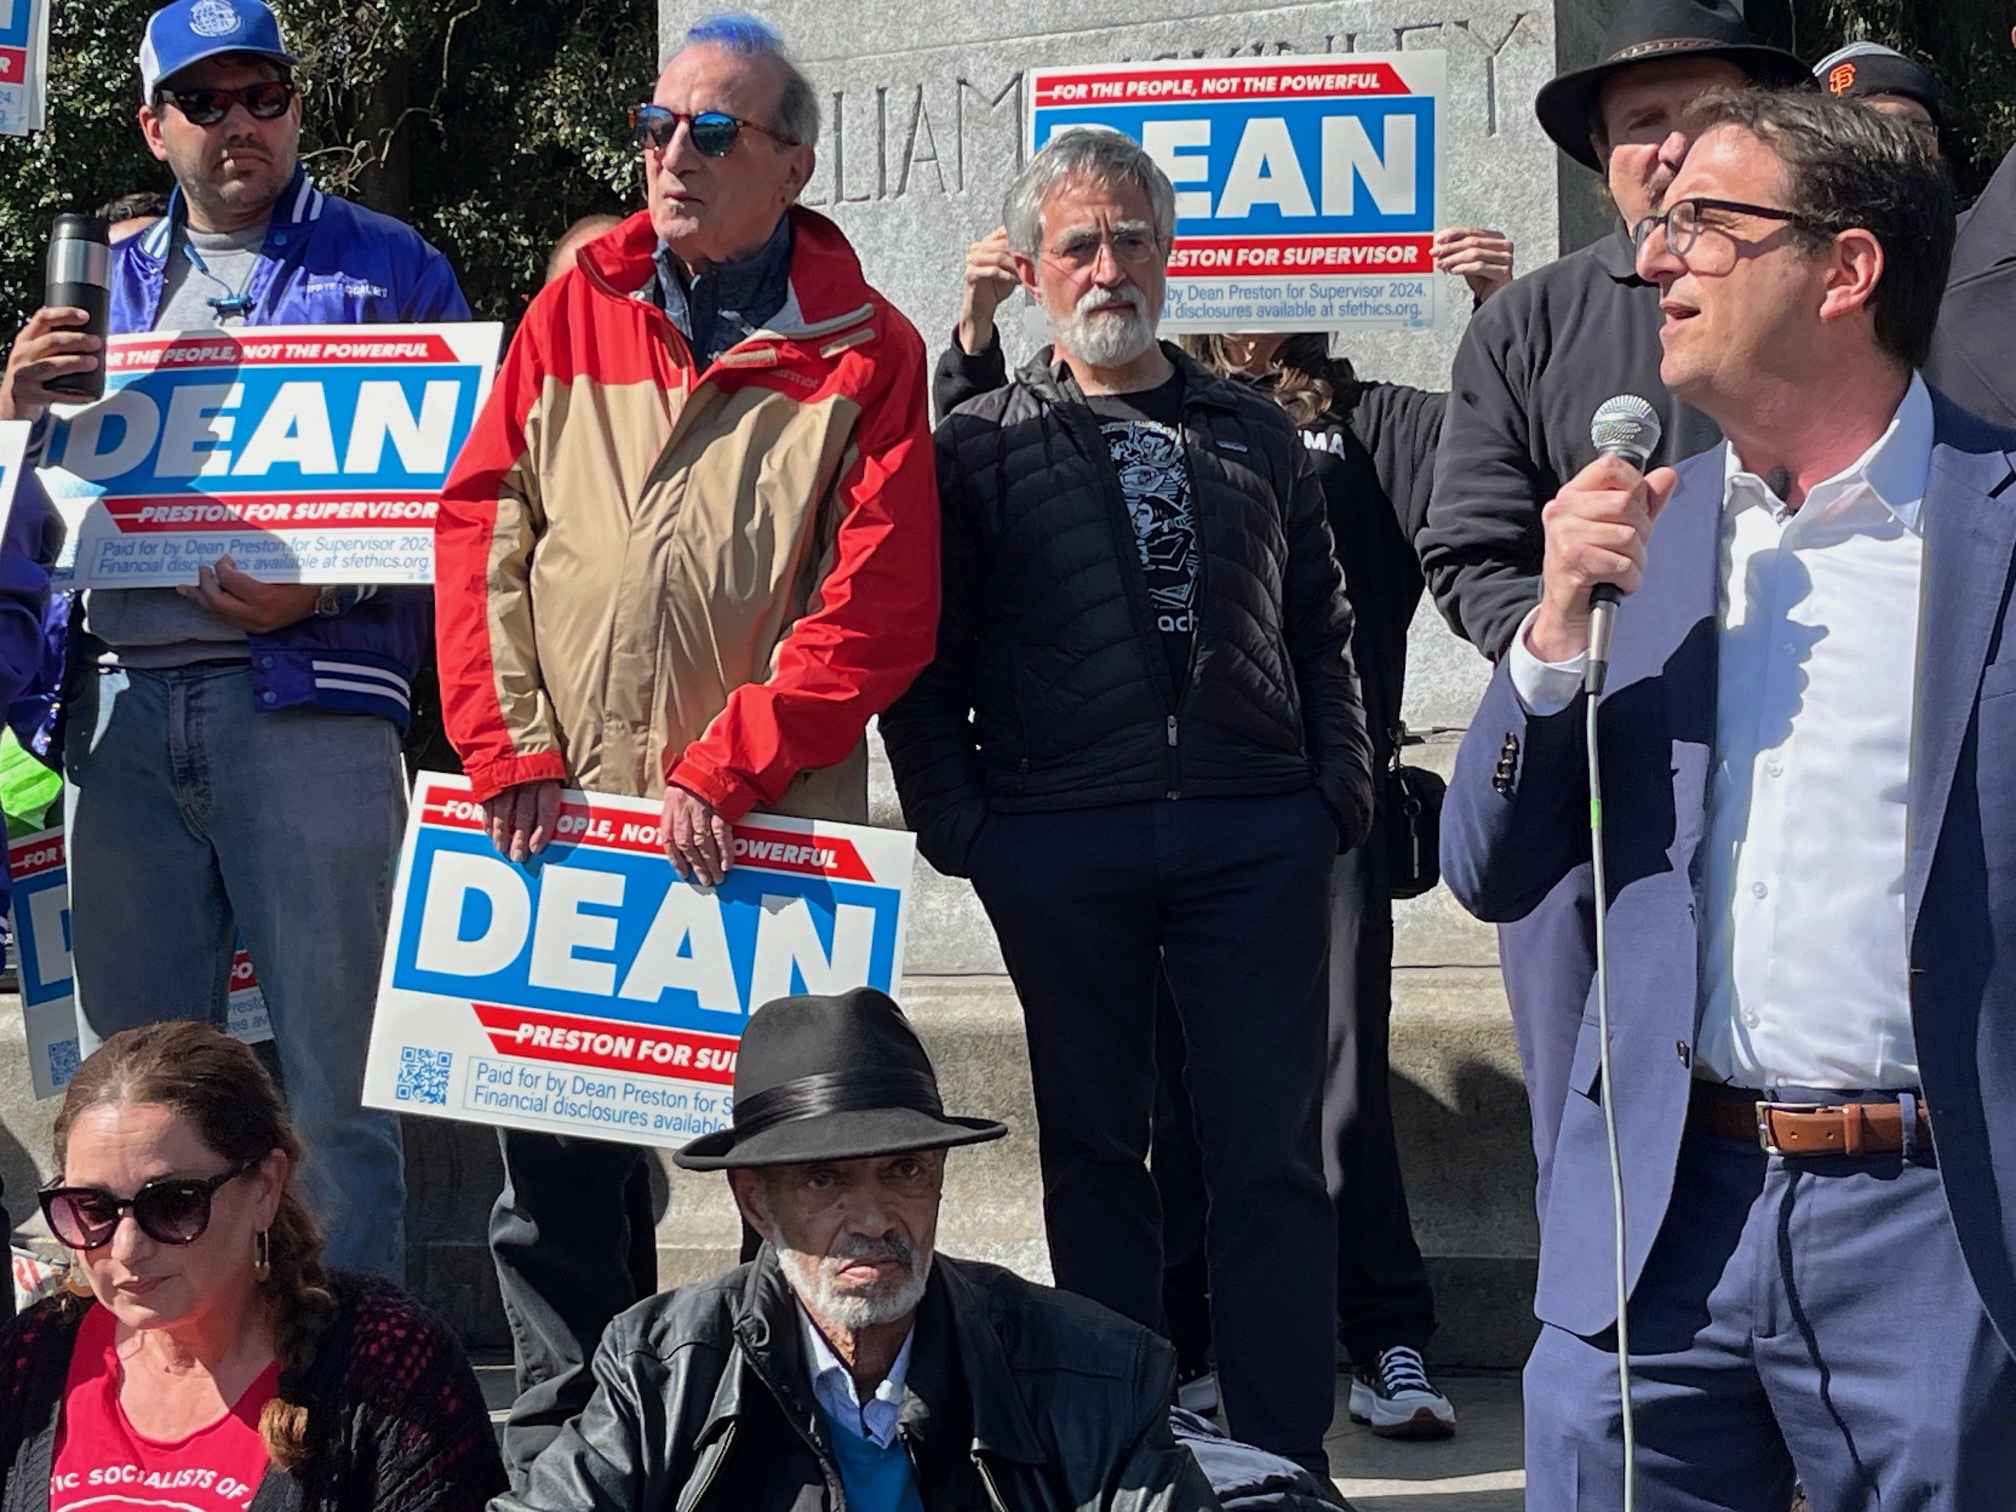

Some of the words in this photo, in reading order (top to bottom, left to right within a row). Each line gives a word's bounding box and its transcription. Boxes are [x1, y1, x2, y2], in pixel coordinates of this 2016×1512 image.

[1052, 84, 1088, 100] FOR
[1091, 81, 1125, 98] THE
[1126, 79, 1198, 97] PEOPLE,
[1202, 77, 1241, 94] NOT
[1243, 76, 1278, 92] THE
[1279, 73, 1381, 92] POWERFUL
[806, 70, 1026, 206] LIAM
[1049, 114, 1416, 219] EAN
[1167, 248, 1233, 268] ESTON
[1236, 247, 1280, 267] FOR
[1282, 245, 1419, 266] SUPERVISOR
[1167, 285, 1183, 305] by
[1188, 284, 1224, 301] Dean
[1229, 284, 1281, 300] Preston
[1286, 283, 1305, 299] for
[1309, 282, 1385, 302] Supervisor
[1389, 282, 1426, 298] 2024.
[1175, 302, 1252, 319] disclosures
[1256, 300, 1316, 318] available
[1320, 302, 1334, 317] at
[1338, 300, 1422, 320] sfethics.org.
[126, 349, 161, 366] THE
[162, 345, 237, 363] PEOPLE,
[238, 343, 283, 360] NOT
[284, 343, 323, 359] THE
[322, 342, 429, 358] POWERFUL
[62, 380, 461, 481] DEAN
[137, 504, 242, 524] PRESTON
[243, 503, 291, 521] FOR
[292, 501, 440, 520] SUPERVISOR
[103, 541, 135, 557] Paid
[138, 541, 160, 556] for
[162, 541, 180, 559] by
[185, 539, 225, 556] Dean
[229, 538, 285, 554] Preston
[289, 536, 312, 552] for
[314, 536, 396, 555] Supervisor
[99, 558, 164, 574] Financial
[253, 554, 318, 570] available
[322, 555, 338, 569] at
[341, 553, 431, 573] sfethics.org.
[557, 815, 616, 843] OPLE,
[24, 847, 57, 869] FOR
[734, 838, 838, 870] OWERFUL
[415, 849, 876, 1016] DEAN
[515, 1023, 634, 1060] PRESTON
[636, 1040, 693, 1067] FOR
[476, 1062, 514, 1086] Paid
[518, 1066, 541, 1090] for
[546, 1070, 568, 1097] by
[572, 1075, 616, 1100] Dean
[623, 1082, 688, 1109] Preston
[694, 1091, 717, 1115] for
[474, 1085, 549, 1113] Financial
[553, 1094, 648, 1128] disclosures
[88, 1464, 218, 1489] SOCIALISTS
[215, 1476, 250, 1500] OF
